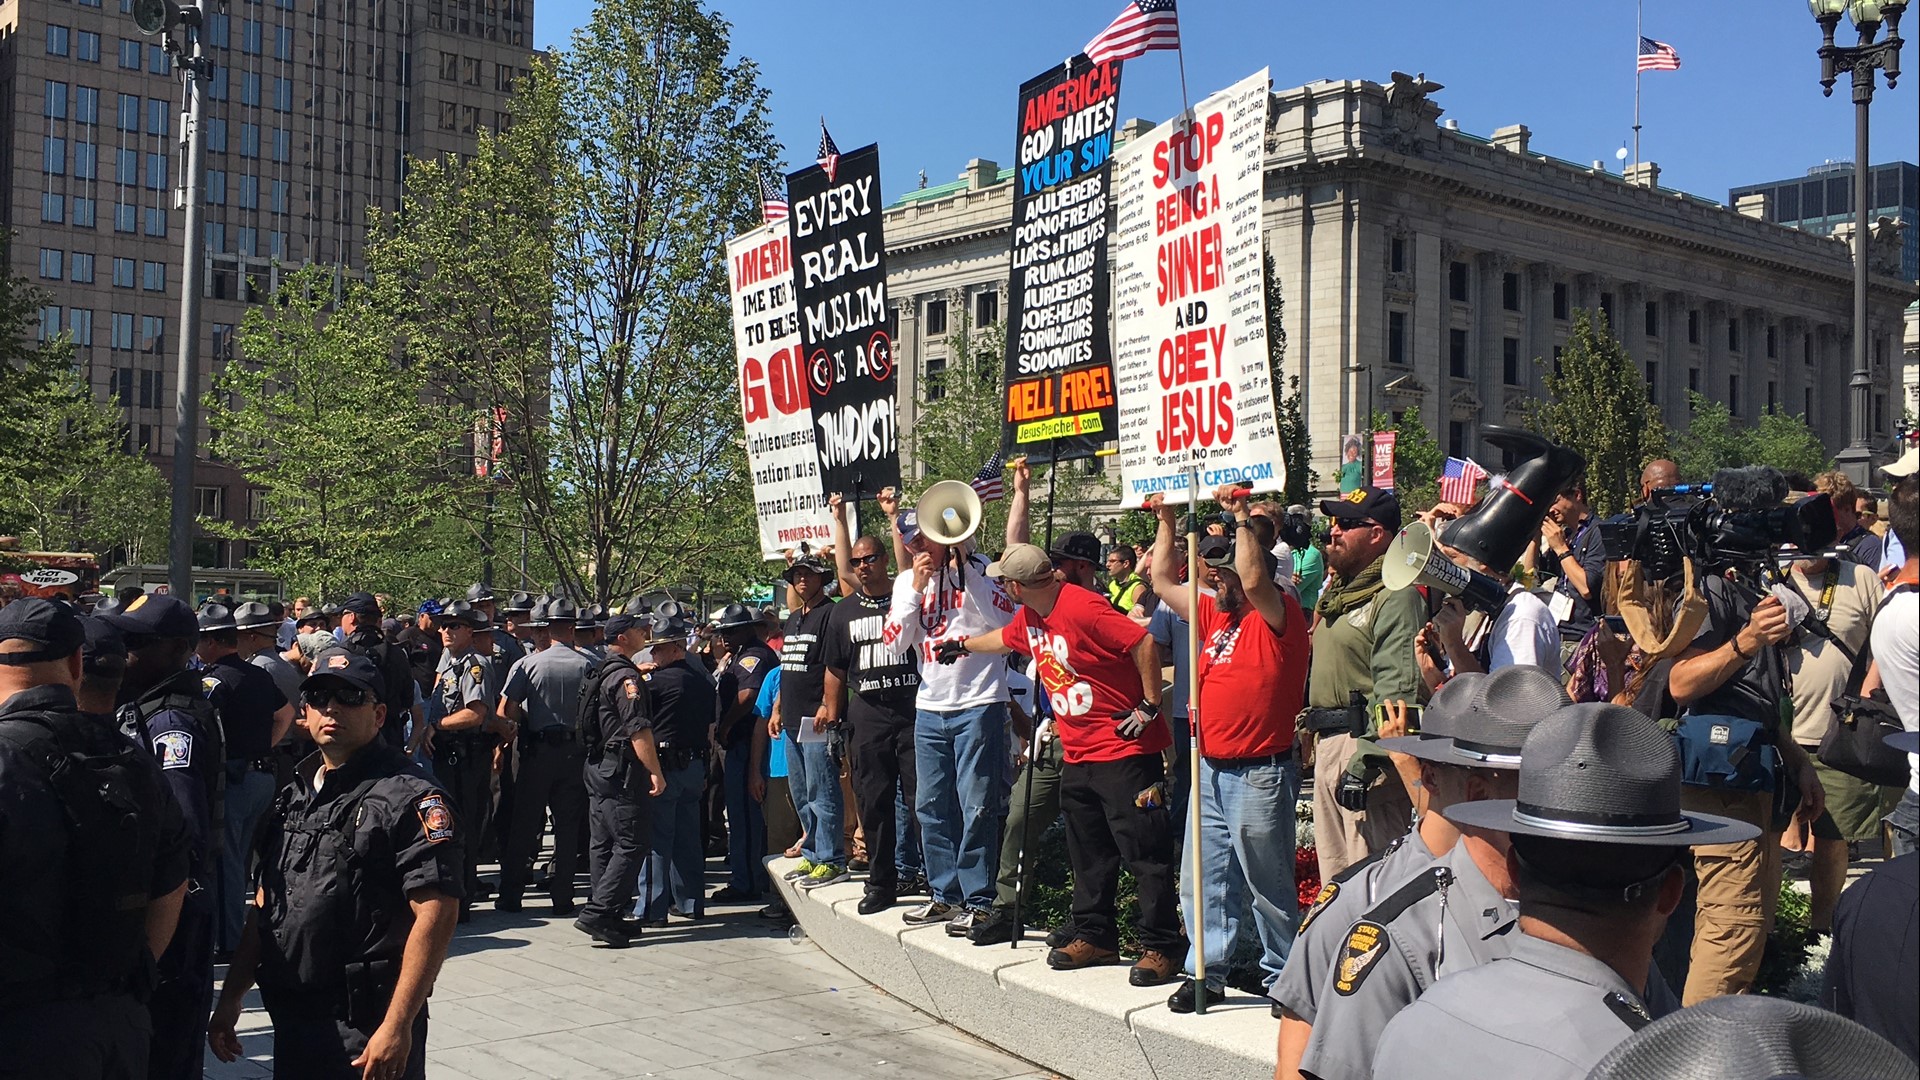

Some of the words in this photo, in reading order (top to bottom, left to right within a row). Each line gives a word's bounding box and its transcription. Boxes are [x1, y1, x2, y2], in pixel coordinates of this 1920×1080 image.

[1023, 62, 1118, 134] AMERICA:
[1248, 90, 1255, 99] ye
[1021, 125, 1054, 165] GOD
[1062, 96, 1115, 148] HATES
[1252, 116, 1263, 126] the
[1022, 150, 1073, 195] YOUR
[1081, 130, 1111, 171] SIN
[1152, 112, 1225, 189] STOP
[1247, 145, 1261, 158] say?
[795, 175, 872, 237] EVERY
[1156, 182, 1207, 236] BEING
[1211, 174, 1220, 213] A
[1013, 240, 1051, 269] LIARS
[1052, 242, 1059, 257] &
[1060, 217, 1105, 255] THIEVES
[735, 235, 794, 292] AMERI
[801, 232, 879, 289] REAL
[1024, 246, 1095, 289] RUNKARDS
[1157, 223, 1225, 306] SINNER
[743, 289, 766, 317] IME
[805, 282, 886, 345] MUSLIM
[1175, 301, 1207, 330] AND
[745, 322, 765, 346] TO
[1018, 316, 1093, 352] FORNICATORS
[1249, 328, 1264, 341] 12:50
[833, 349, 847, 384] IS
[856, 345, 870, 377] A
[1018, 339, 1093, 373] SODOMITES
[1158, 323, 1226, 390] OBEY
[1008, 378, 1054, 422] HELL
[1060, 366, 1113, 413] FIRE!
[1260, 377, 1268, 388] ye
[818, 394, 896, 470] JIHADIST!
[1156, 381, 1234, 454] JESUS
[1261, 411, 1272, 423] you
[1125, 459, 1137, 467] John
[1168, 453, 1180, 464] and
[1192, 448, 1207, 460] NO
[1210, 444, 1237, 458] more"
[1375, 443, 1392, 454] WE
[756, 462, 790, 485] nation
[849, 615, 883, 644] PROUD
[859, 645, 871, 670] AN
[882, 675, 892, 688] is
[894, 677, 900, 686] a
[902, 673, 918, 686] LIE
[1051, 681, 1093, 716] OD
[1349, 940, 1370, 952] PATROL
[1357, 925, 1379, 937] STATE
